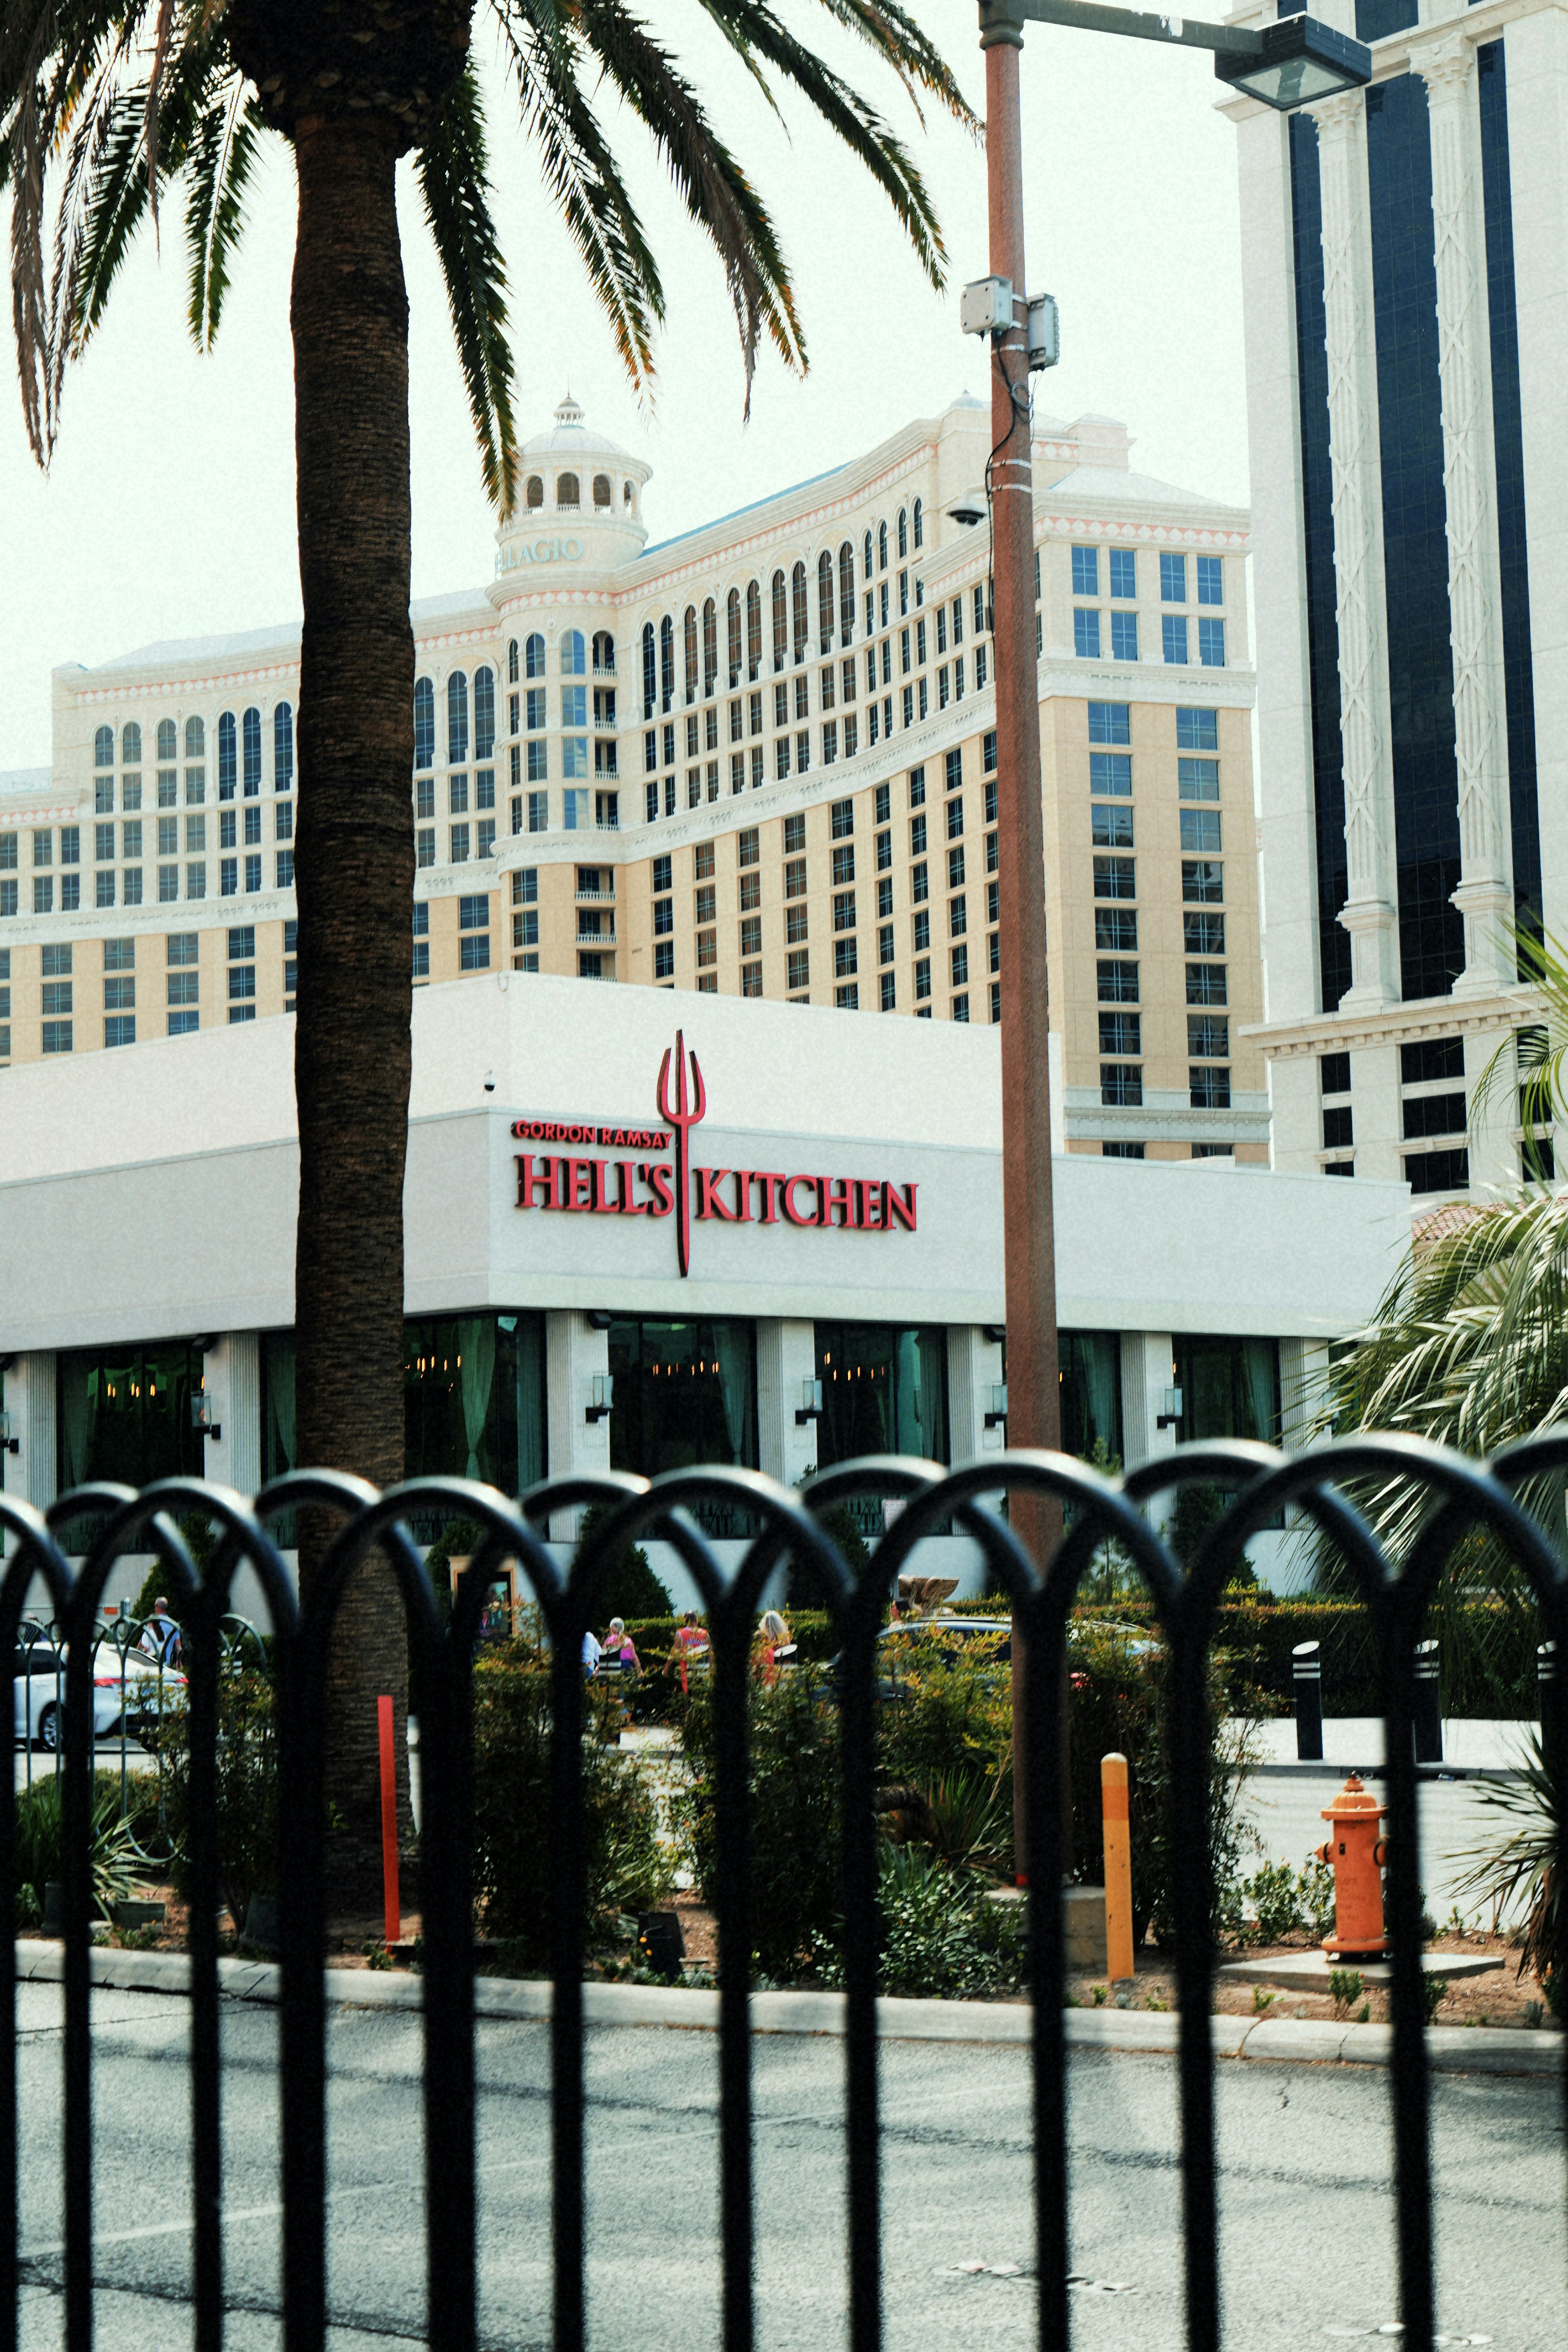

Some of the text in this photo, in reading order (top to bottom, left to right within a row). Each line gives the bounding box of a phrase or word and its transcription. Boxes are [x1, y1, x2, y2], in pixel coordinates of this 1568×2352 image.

[511, 1120, 673, 1149] GORDON RAMSAY
[514, 1155, 919, 1231] HELL'S KITCHEN
